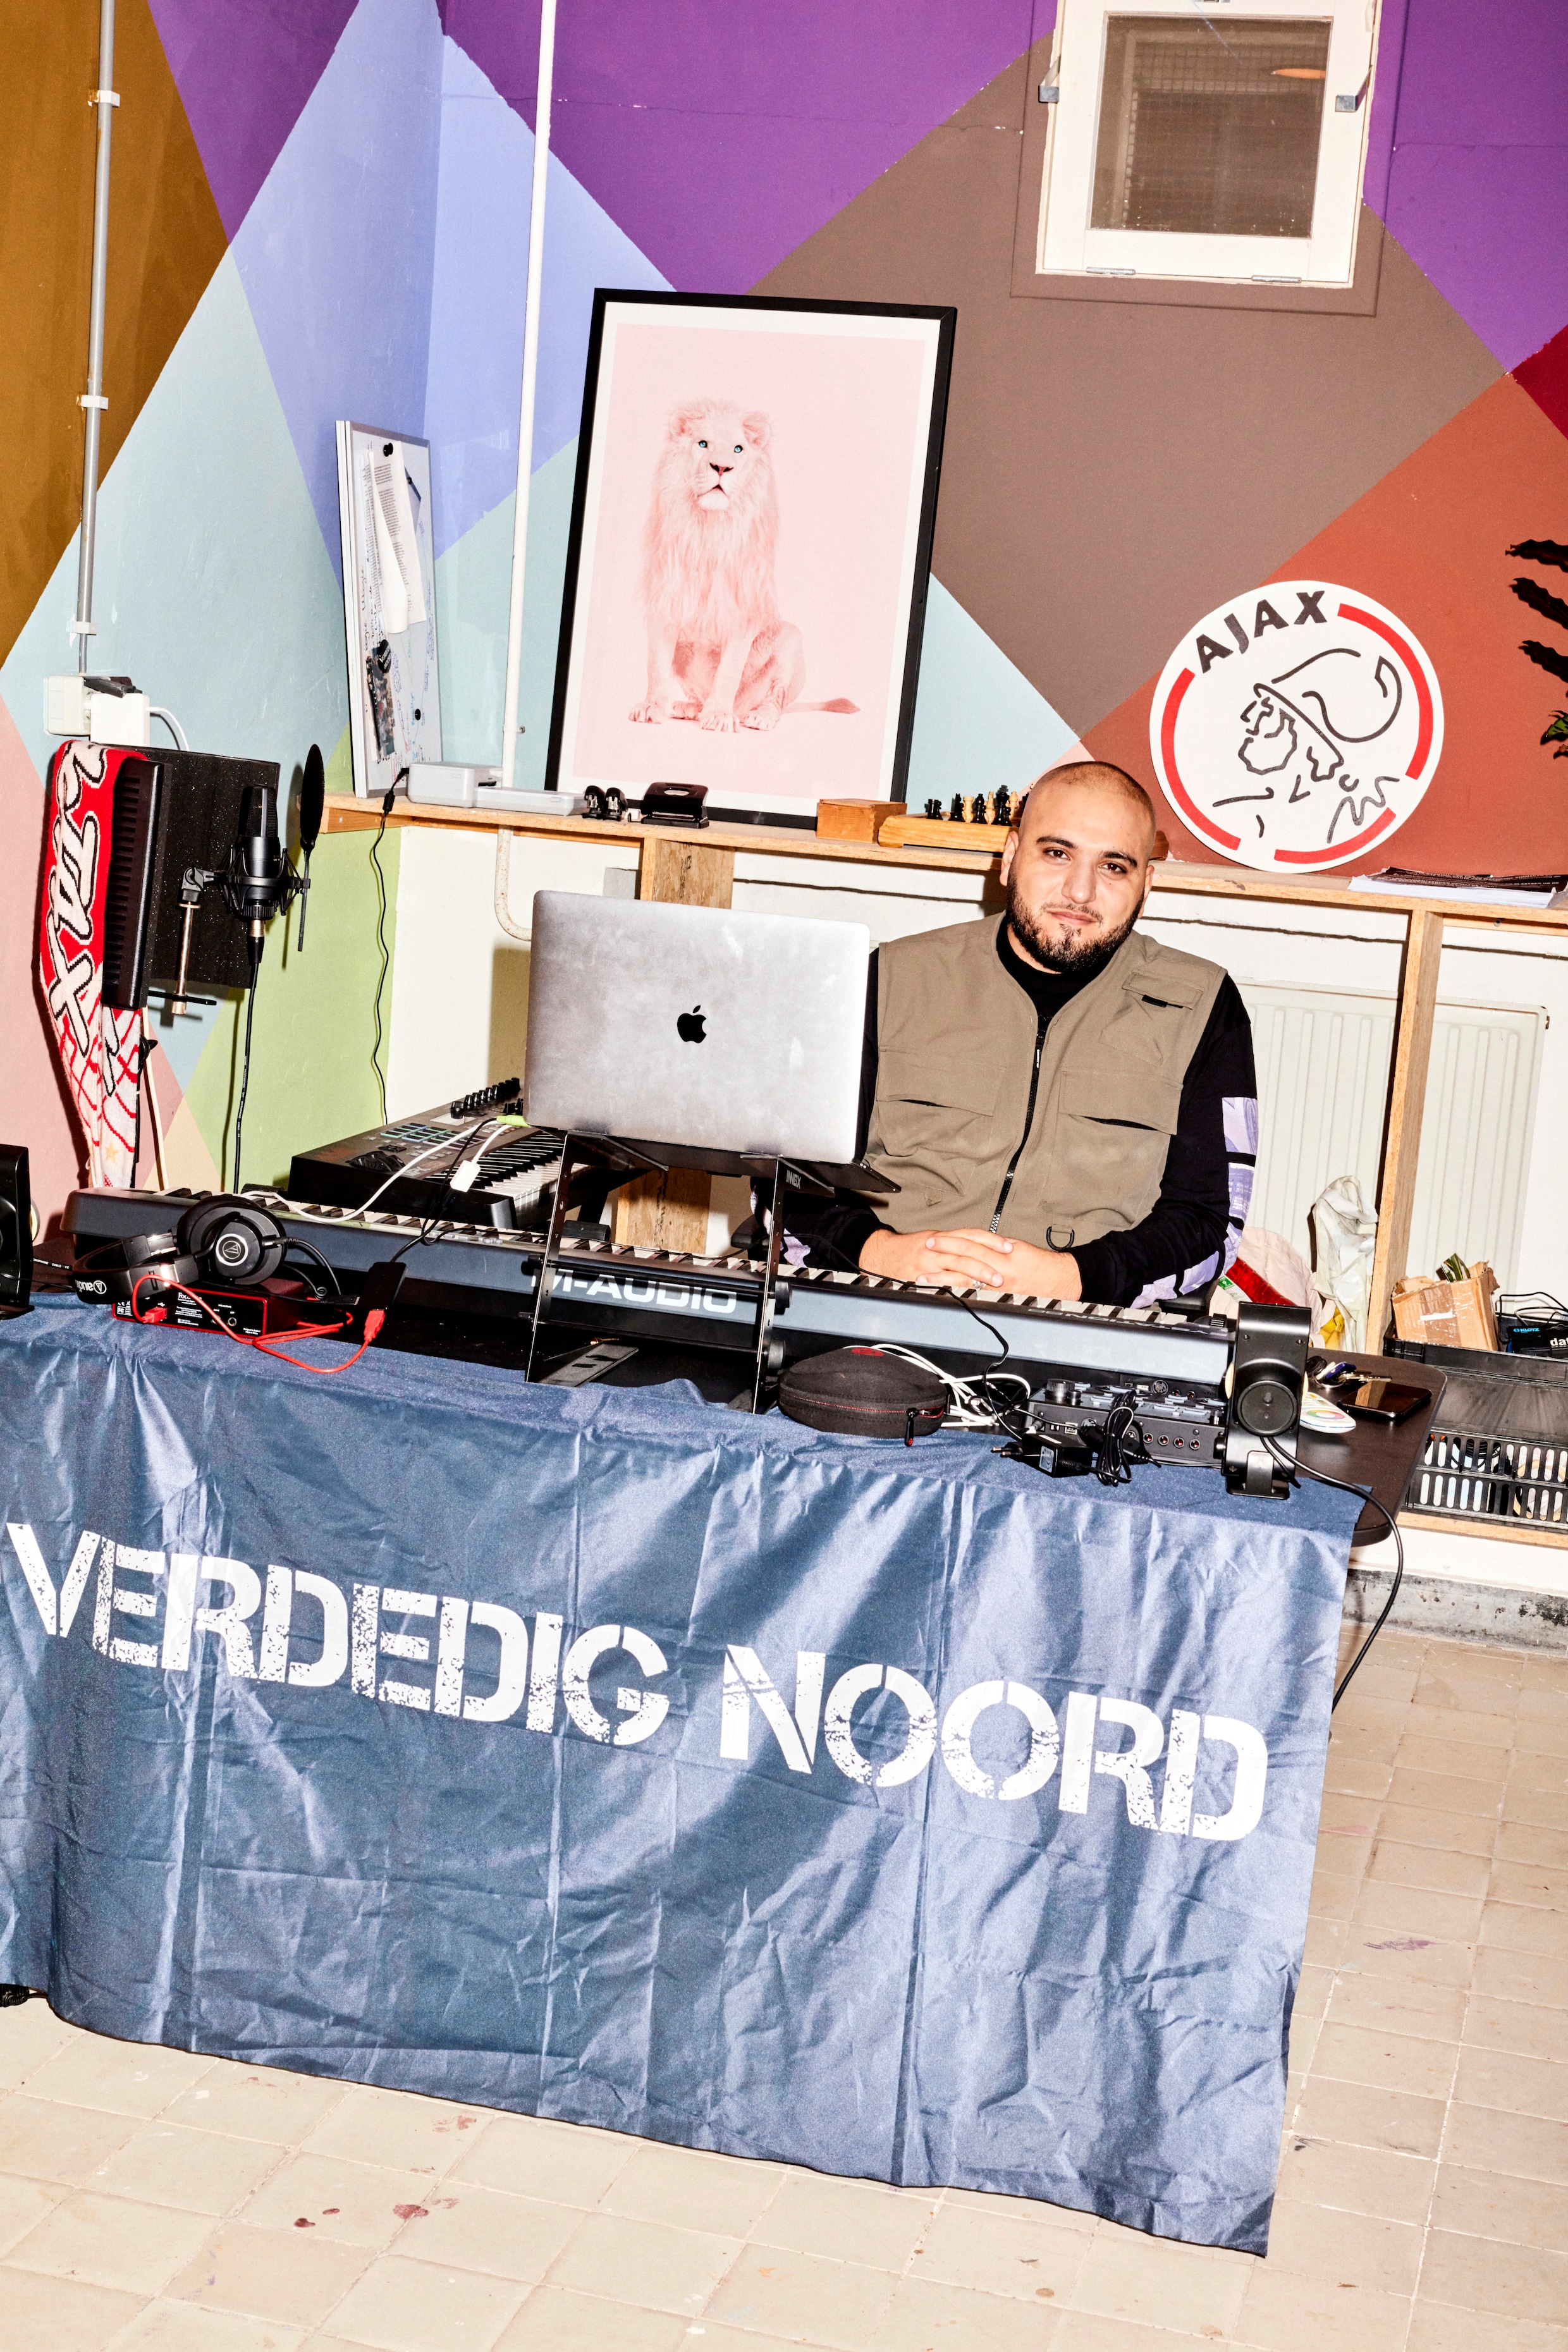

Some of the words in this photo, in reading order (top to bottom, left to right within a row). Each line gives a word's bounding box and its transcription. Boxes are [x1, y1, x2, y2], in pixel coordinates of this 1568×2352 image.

[1195, 590, 1327, 673] AJAX
[6, 1522, 670, 1746] VERDEDIG
[720, 1645, 1268, 1841] NOORD
